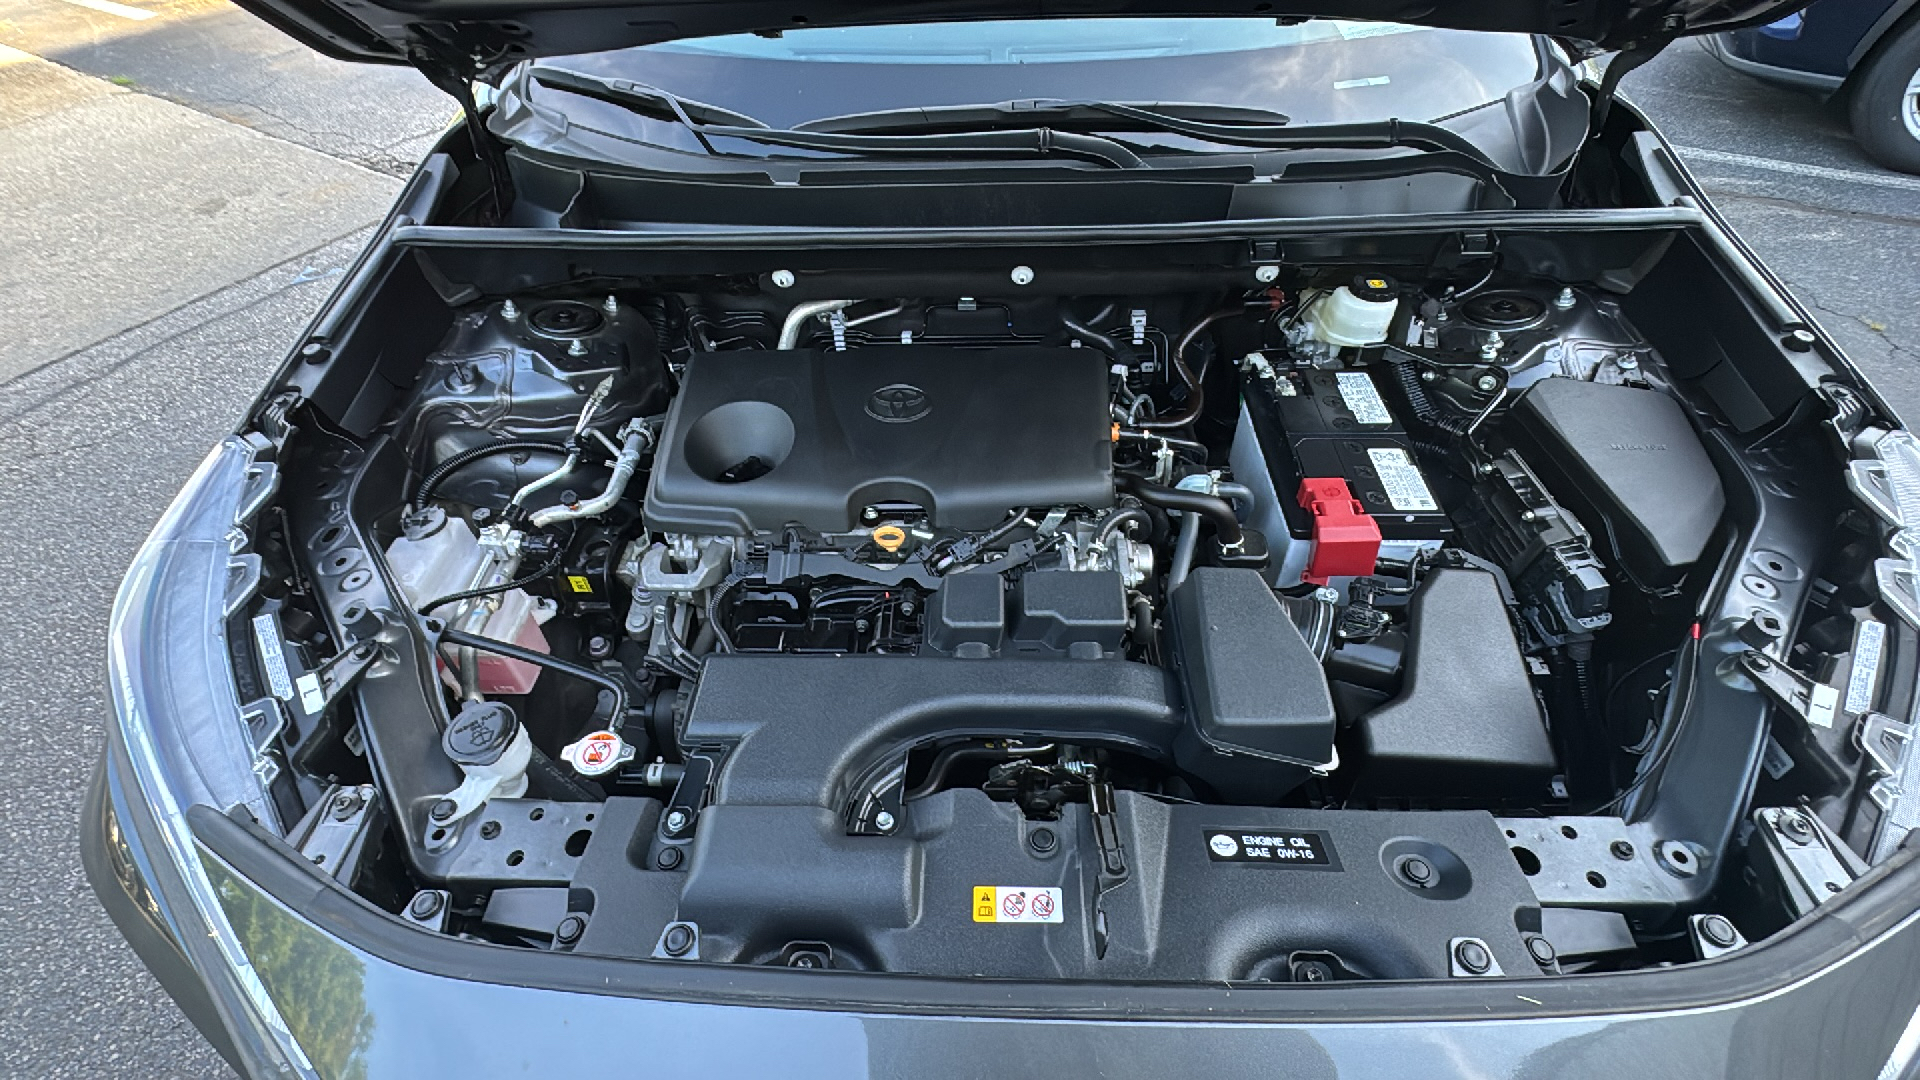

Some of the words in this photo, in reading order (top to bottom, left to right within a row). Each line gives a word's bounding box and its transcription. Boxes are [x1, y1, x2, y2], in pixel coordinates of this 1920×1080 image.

[1242, 835, 1285, 847] ENGINE
[1289, 837, 1311, 848] OIL
[1246, 847, 1271, 858] SAE
[1277, 848, 1315, 860] 0W-16
